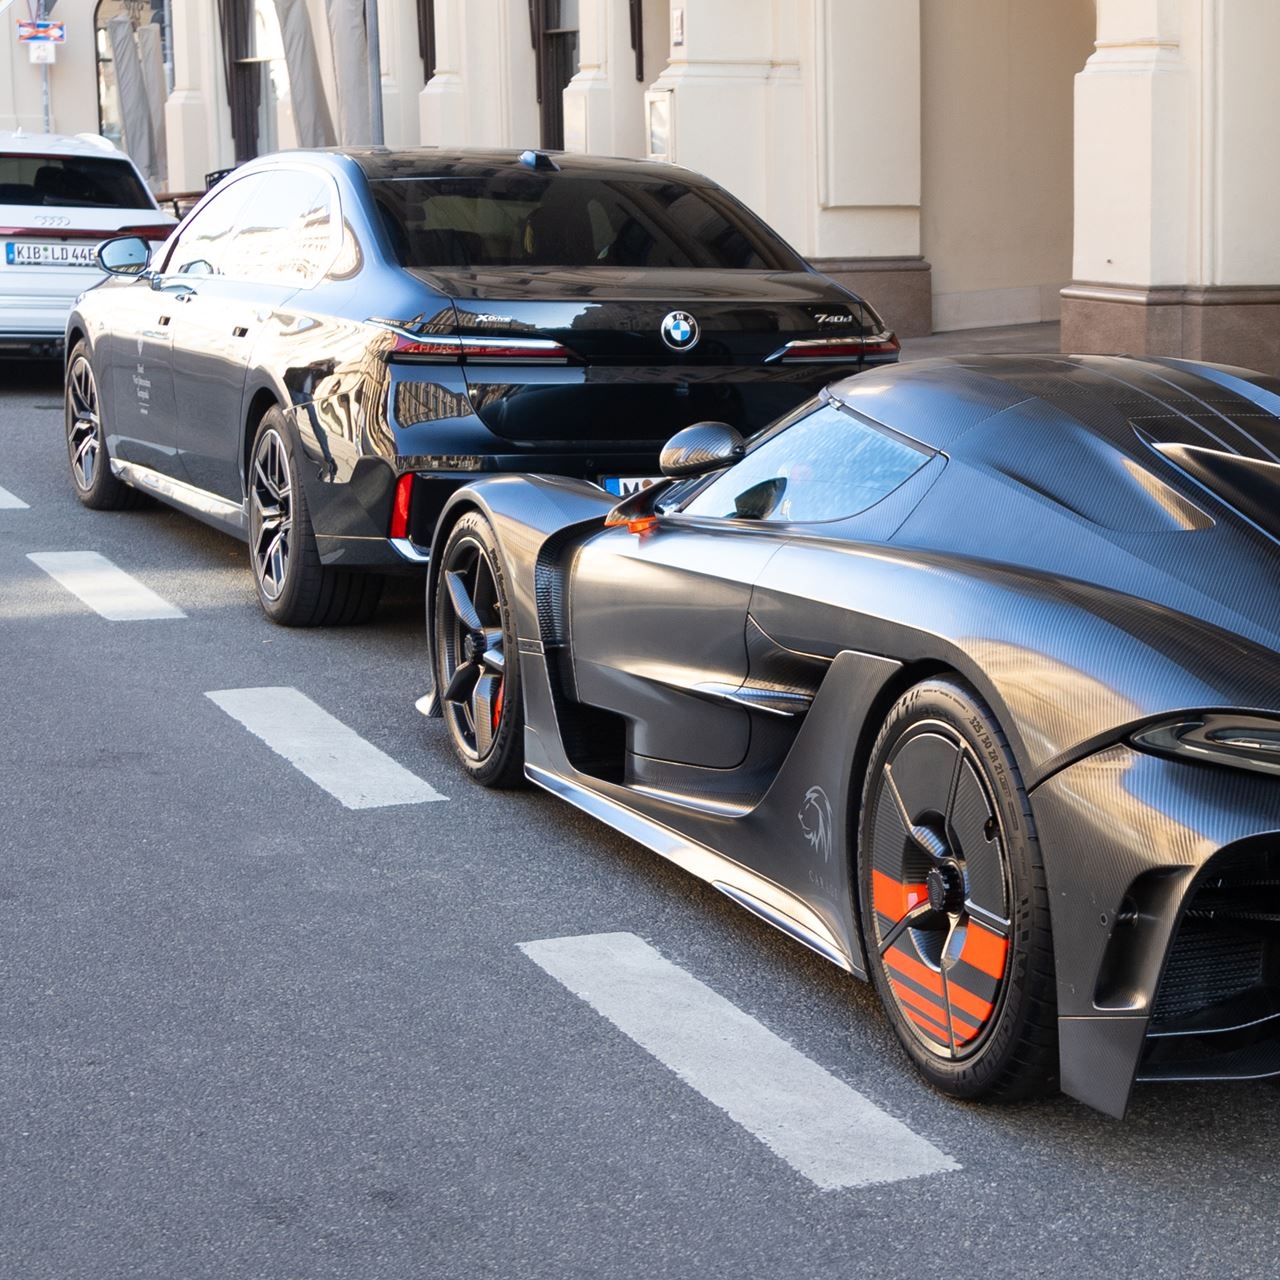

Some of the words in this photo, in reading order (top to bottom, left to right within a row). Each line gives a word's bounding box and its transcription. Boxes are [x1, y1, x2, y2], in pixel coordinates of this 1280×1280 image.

[17, 246, 41, 260] KIB
[52, 248, 69, 261] LD
[623, 481, 640, 495] M
